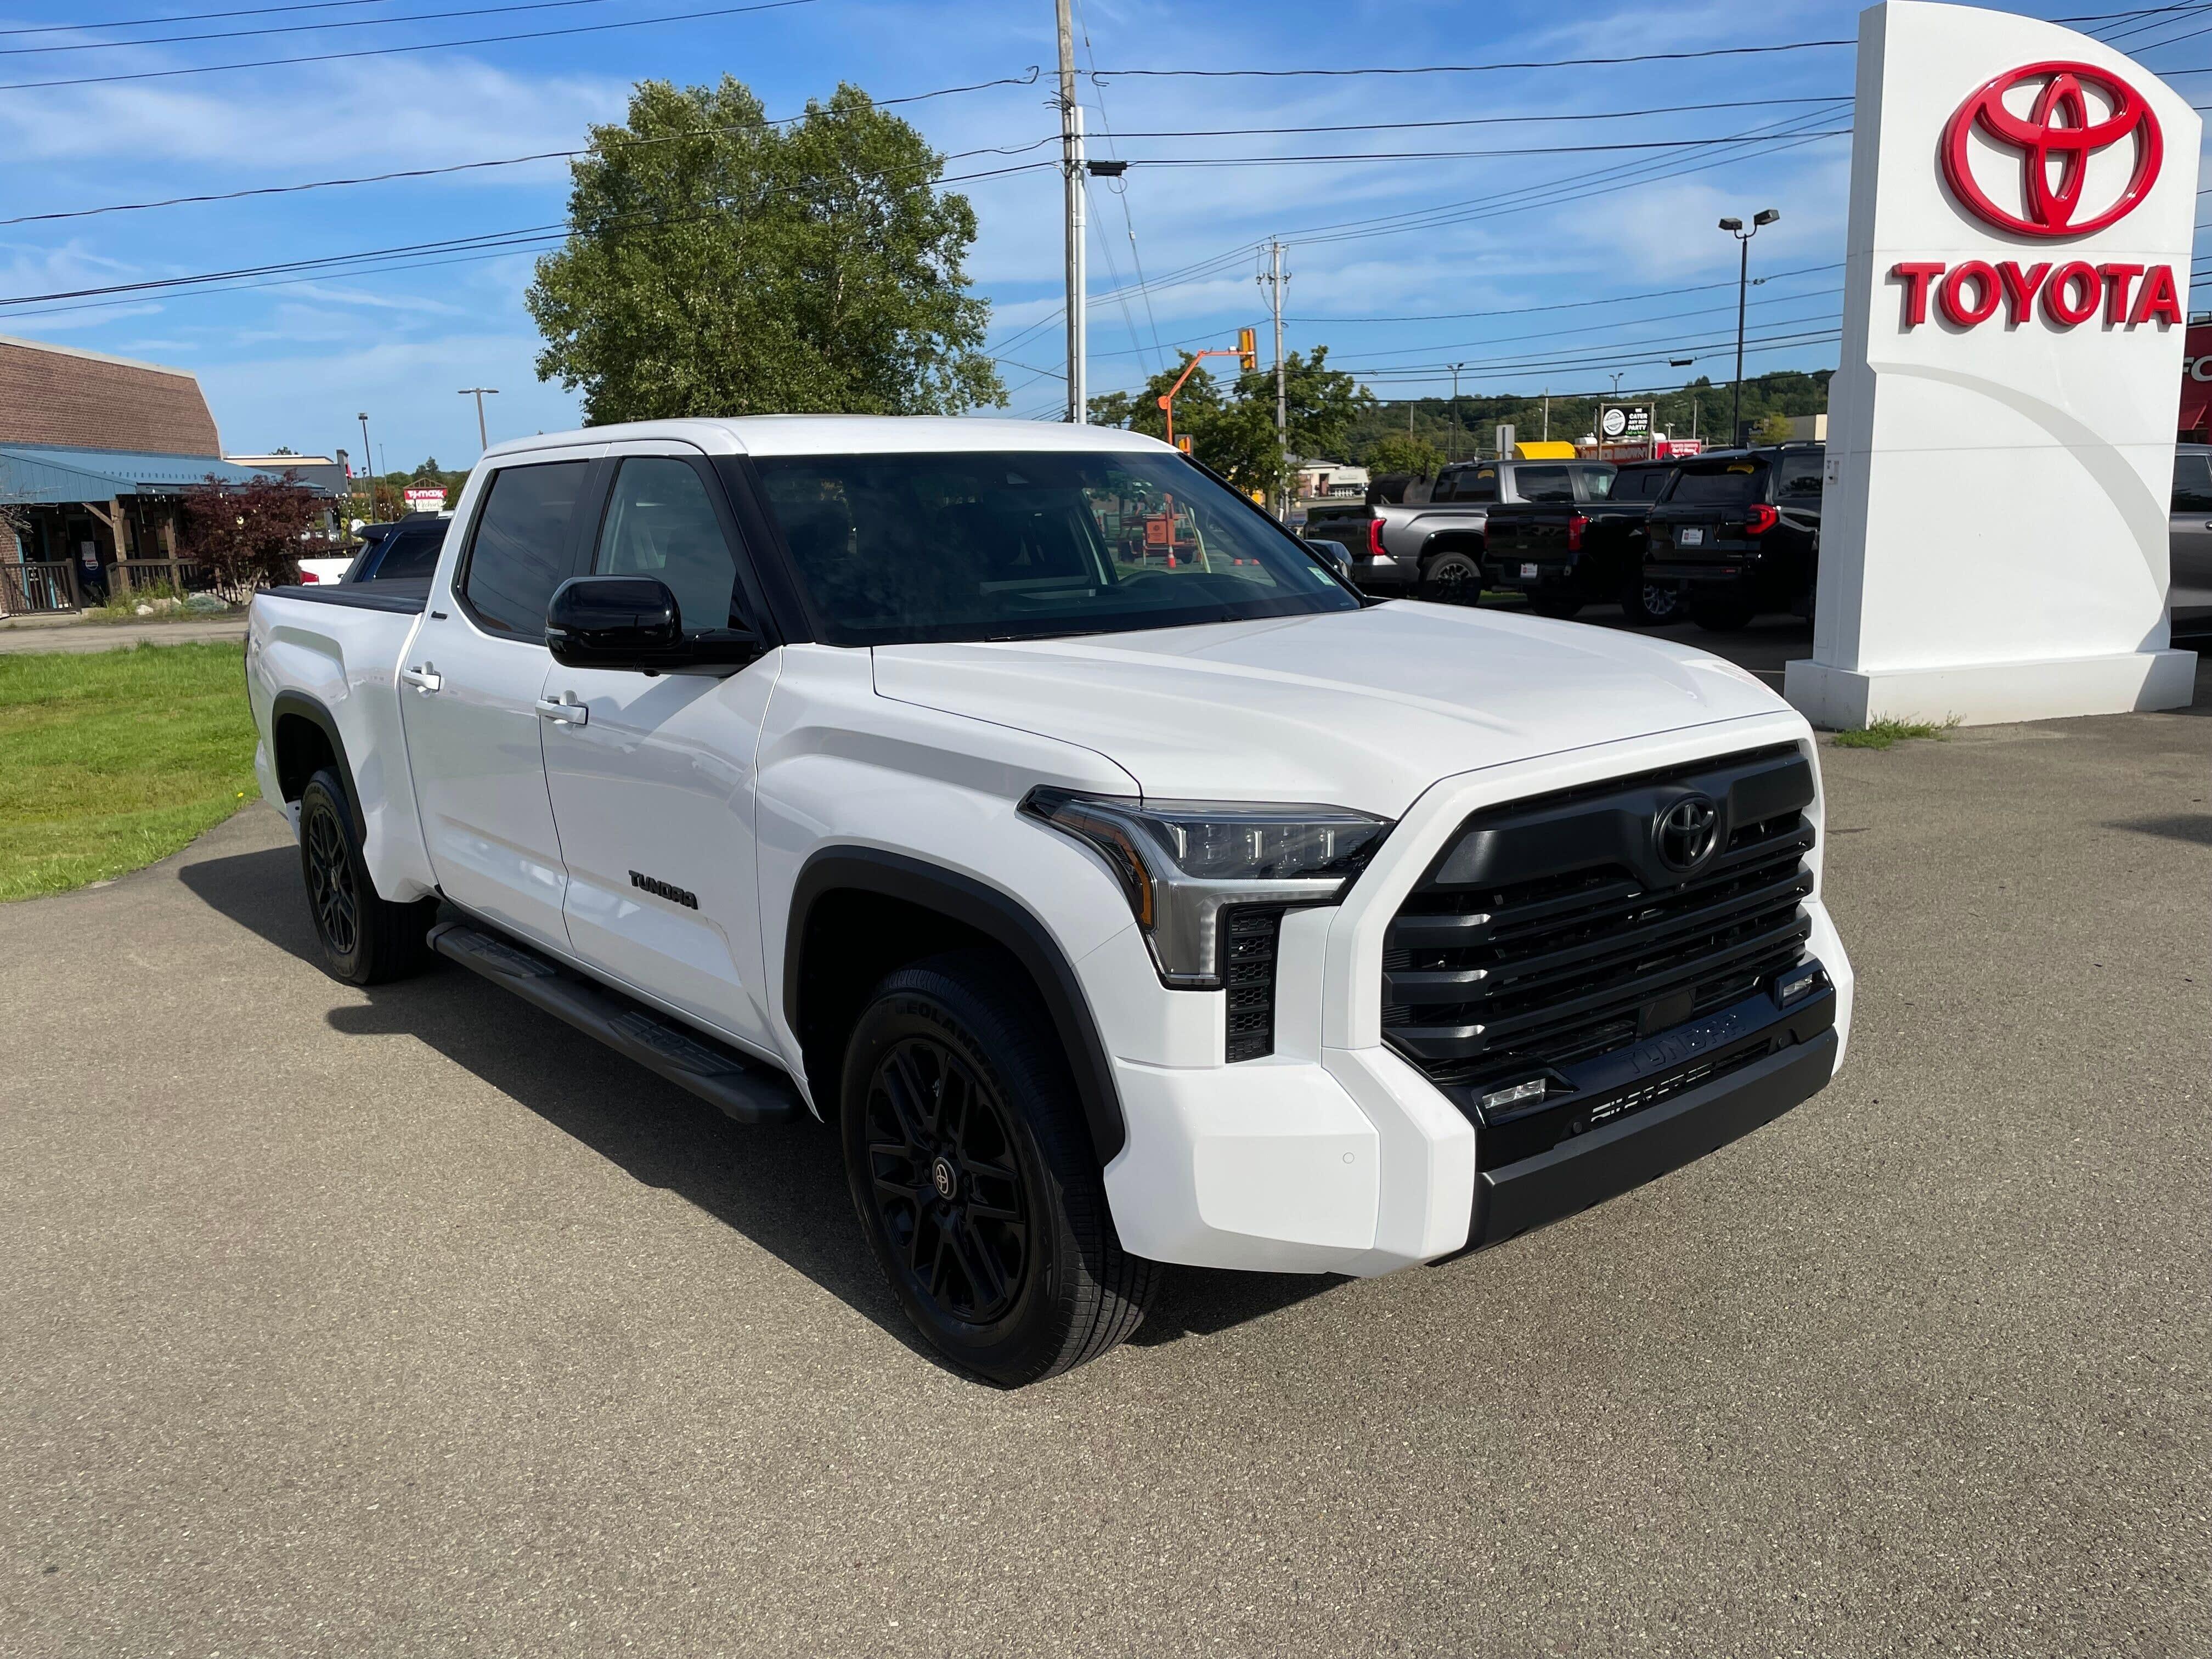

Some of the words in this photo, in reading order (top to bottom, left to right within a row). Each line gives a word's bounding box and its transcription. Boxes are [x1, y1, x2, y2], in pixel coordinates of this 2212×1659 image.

[1893, 260, 2182, 326] TOYOTA
[628, 870, 698, 910] TUNDRA
[1613, 1013, 1747, 1074] TUNDRA
